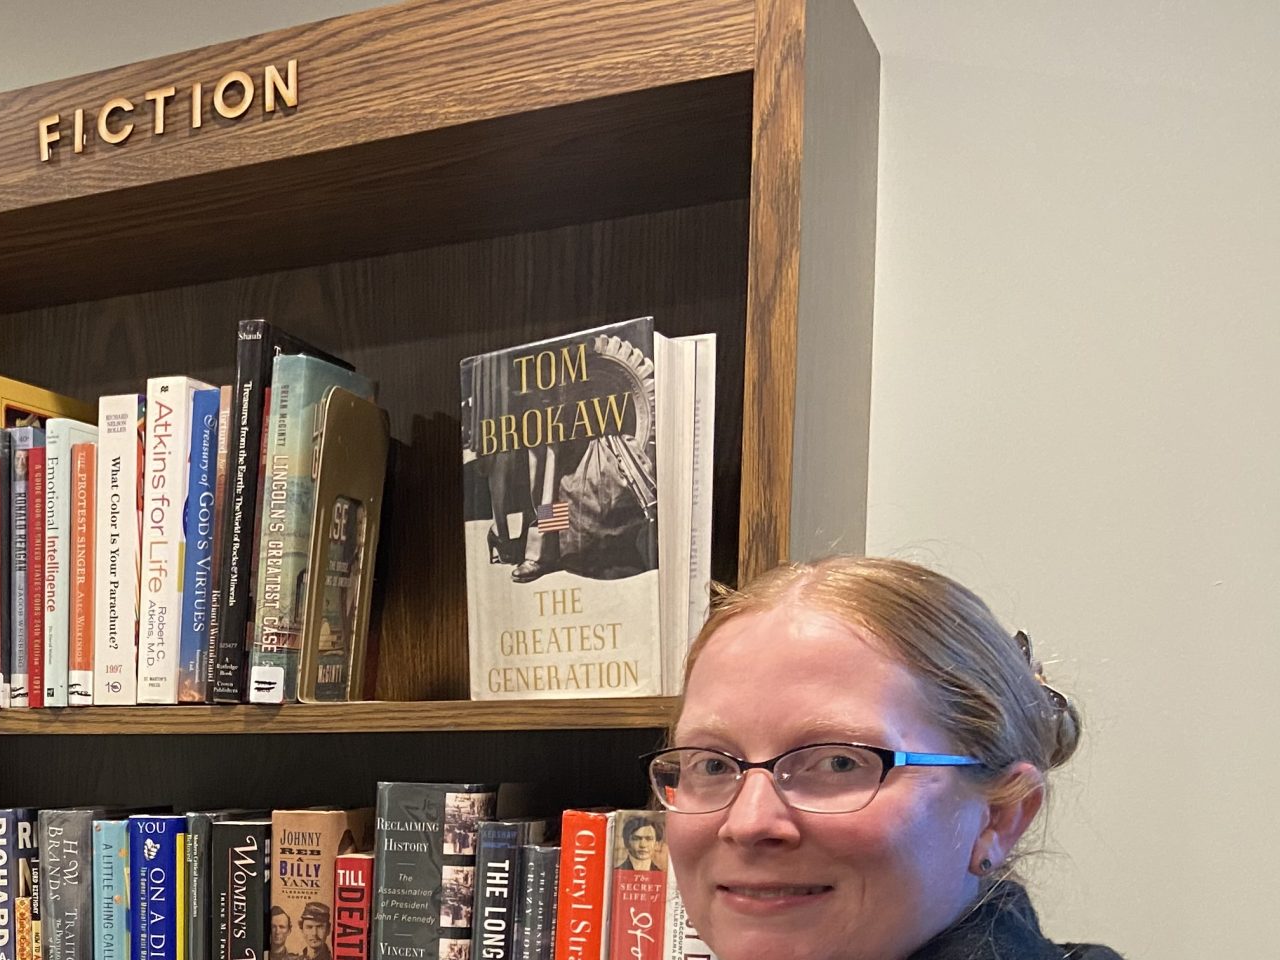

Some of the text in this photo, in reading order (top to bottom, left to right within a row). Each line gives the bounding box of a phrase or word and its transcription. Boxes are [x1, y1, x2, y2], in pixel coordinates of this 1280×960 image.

[39, 59, 298, 162] FICTION
[513, 344, 590, 394] TOM
[481, 392, 632, 456] BROKAW
[148, 401, 172, 593] Atkins for Life
[200, 477, 208, 487] of
[46, 457, 58, 612] Emotional Intelligence
[197, 491, 215, 550] GOD'S
[109, 457, 121, 649] What Color Is Your Parachute?
[262, 455, 289, 652] LINCOLN'S GREATEST CASE
[193, 555, 211, 633] VIRTUES
[534, 588, 583, 617] THE
[500, 623, 622, 657] GREATEST
[488, 660, 639, 693] GENERATION
[137, 822, 166, 834] YOU
[280, 829, 321, 846] JOHNNY
[377, 817, 440, 832] RECLAIMING
[47, 825, 63, 901] BRANDS
[280, 848, 320, 856] REB
[384, 840, 429, 853] HISTORY
[150, 868, 165, 901] ON
[279, 861, 320, 877] BILLY
[280, 877, 320, 888] YANK
[338, 869, 366, 886] TILL
[399, 873, 413, 882] The
[485, 860, 509, 897] THE
[572, 830, 595, 914] Cheryl
[232, 835, 258, 938] WOMEN'S
[378, 888, 433, 897] Assassination
[621, 882, 661, 892] SECRET
[151, 906, 165, 923] A
[379, 943, 426, 958] VINCENT
